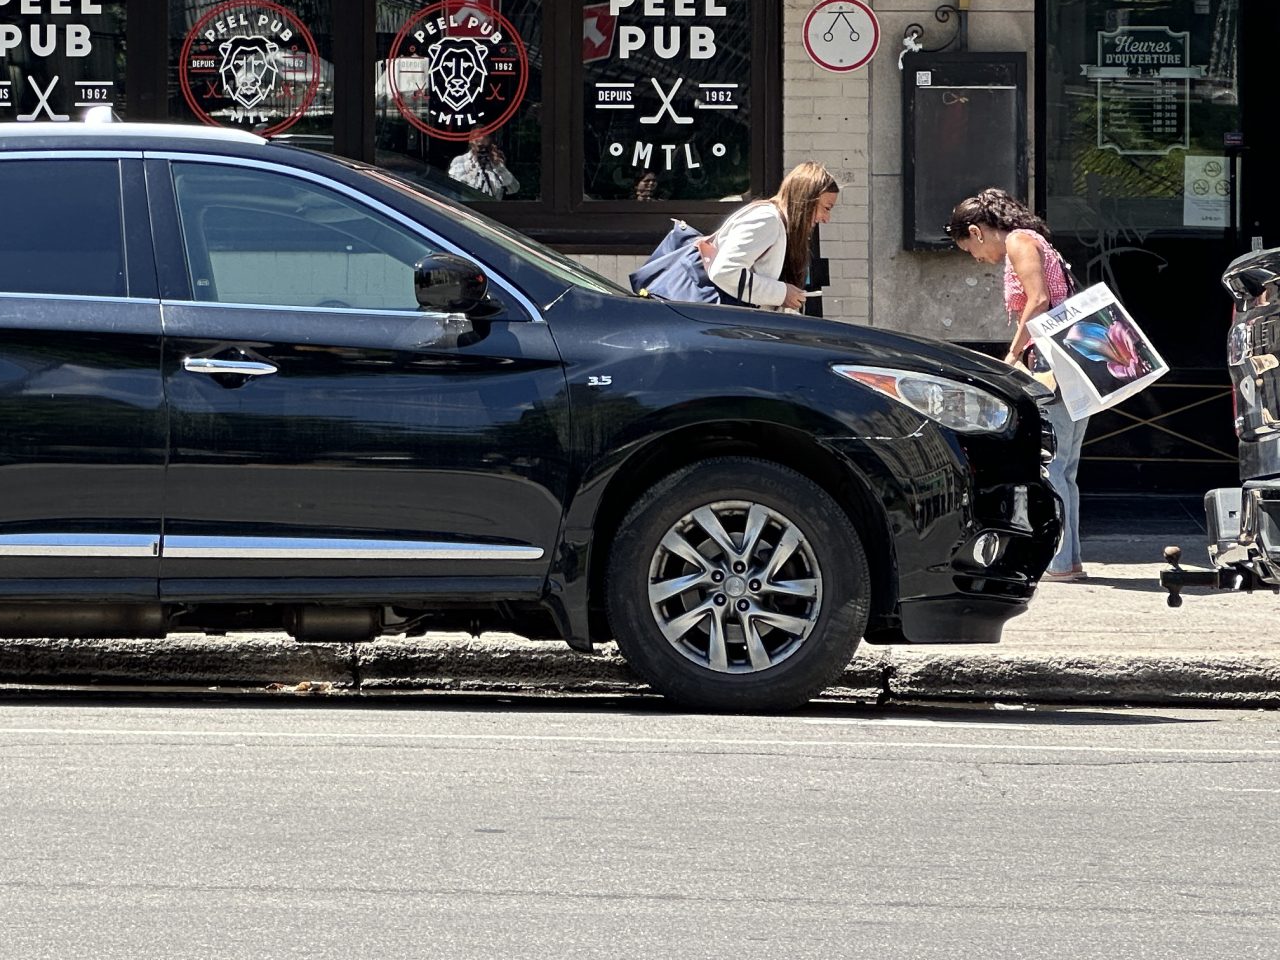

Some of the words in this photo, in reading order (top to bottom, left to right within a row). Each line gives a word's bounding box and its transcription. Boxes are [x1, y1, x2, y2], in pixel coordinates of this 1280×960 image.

[204, 14, 247, 43] PEEL
[257, 14, 295, 43] PUB
[414, 14, 459, 44] PEEL
[467, 16, 503, 45] PUB
[619, 25, 717, 60] PUB
[1114, 35, 1173, 54] Heures
[192, 59, 216, 68] DEPUIS
[1105, 53, 1182, 65] D'OUVERTURE
[494, 62, 514, 71] 1962
[81, 88, 108, 100] 1962
[598, 90, 632, 102] DEPUIS
[704, 90, 732, 102] 1962
[437, 113, 477, 127] MTL
[632, 141, 701, 171] MTL
[1040, 305, 1082, 334] ARITZIA
[587, 375, 613, 386] 3.5
